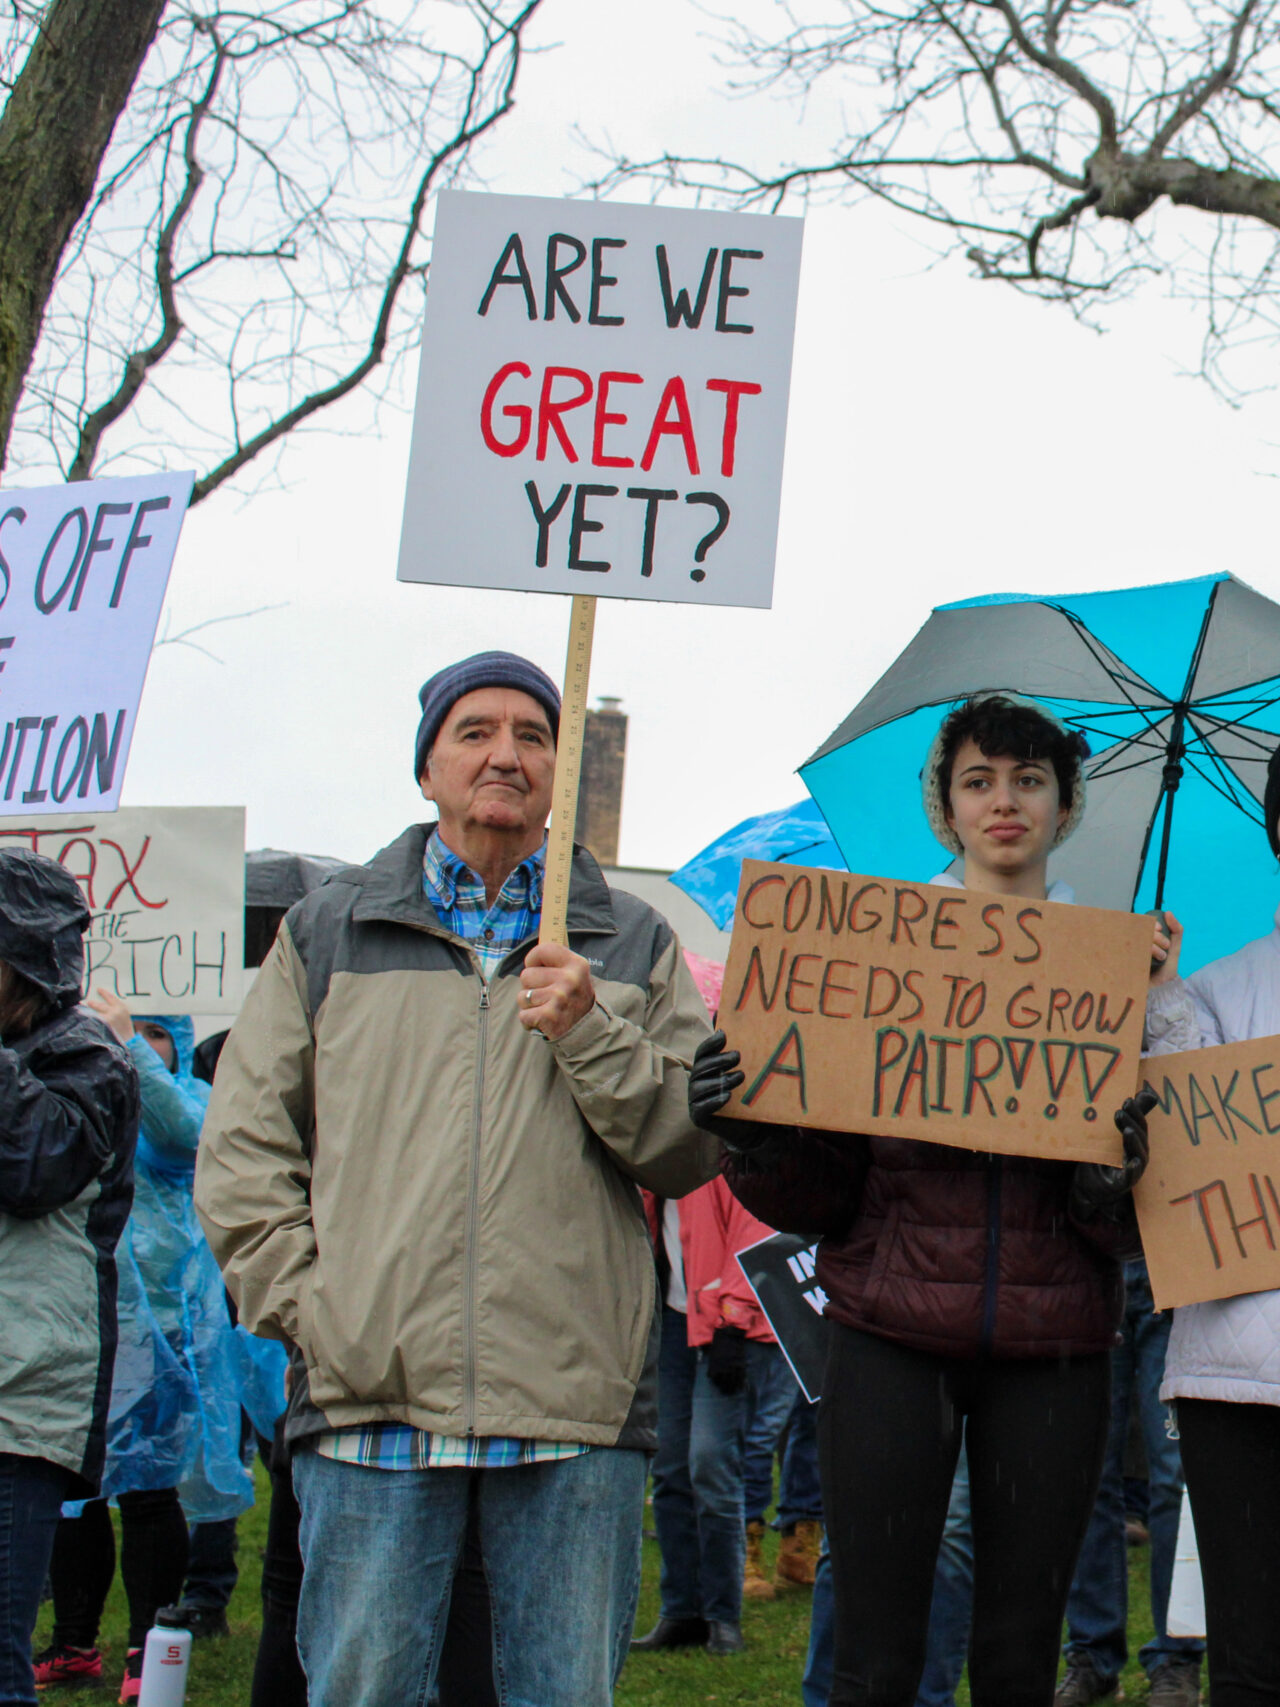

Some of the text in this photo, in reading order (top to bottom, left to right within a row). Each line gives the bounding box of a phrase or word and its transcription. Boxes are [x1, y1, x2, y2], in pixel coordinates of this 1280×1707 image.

[478, 233, 764, 334] ARE WE
[480, 361, 762, 477] GREAT
[34, 496, 172, 616] OFF
[524, 480, 730, 582] YET?
[83, 931, 225, 1000] RICH
[88, 910, 142, 939] THE
[742, 874, 1043, 964] CONGRESS
[735, 946, 1135, 1035] NEEDS TO GROW
[741, 1021, 1122, 1122] A PAIR!!!
